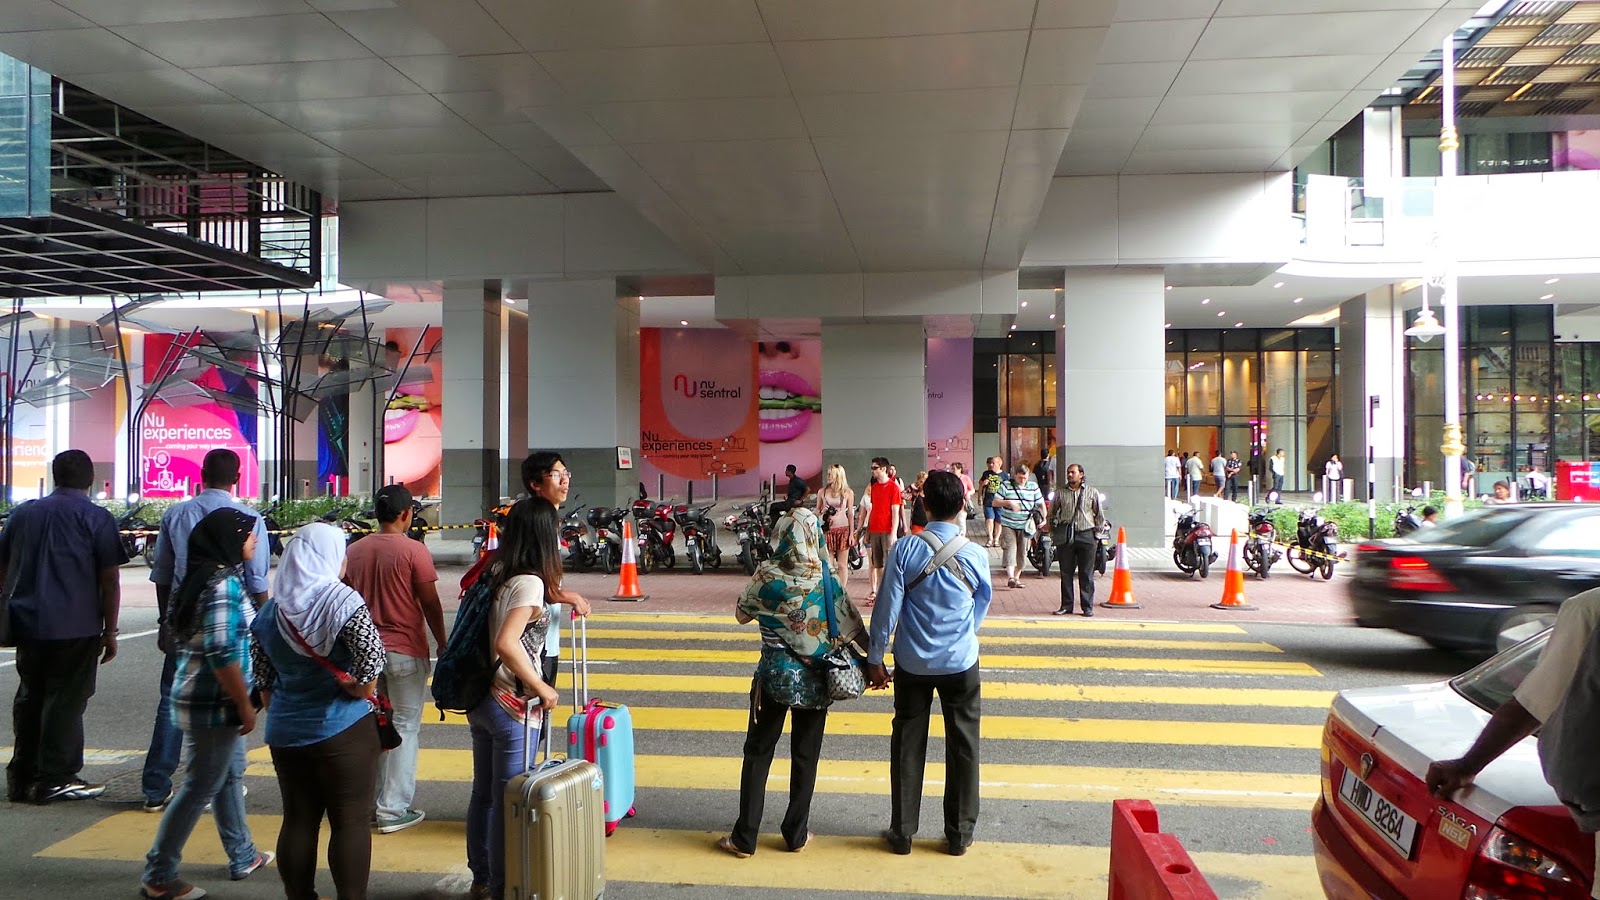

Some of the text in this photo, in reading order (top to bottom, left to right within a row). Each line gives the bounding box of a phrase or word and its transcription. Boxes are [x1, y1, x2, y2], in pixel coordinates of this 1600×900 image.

[700, 381, 715, 389] nu
[700, 386, 741, 398] sentral
[143, 412, 165, 428] Nu
[143, 424, 233, 443] experiences
[642, 431, 659, 442] Nu
[641, 439, 713, 453] experiences
[1374, 798, 1404, 841] 8264
[1436, 805, 1477, 836] SAGA
[1441, 823, 1468, 842] NGV
